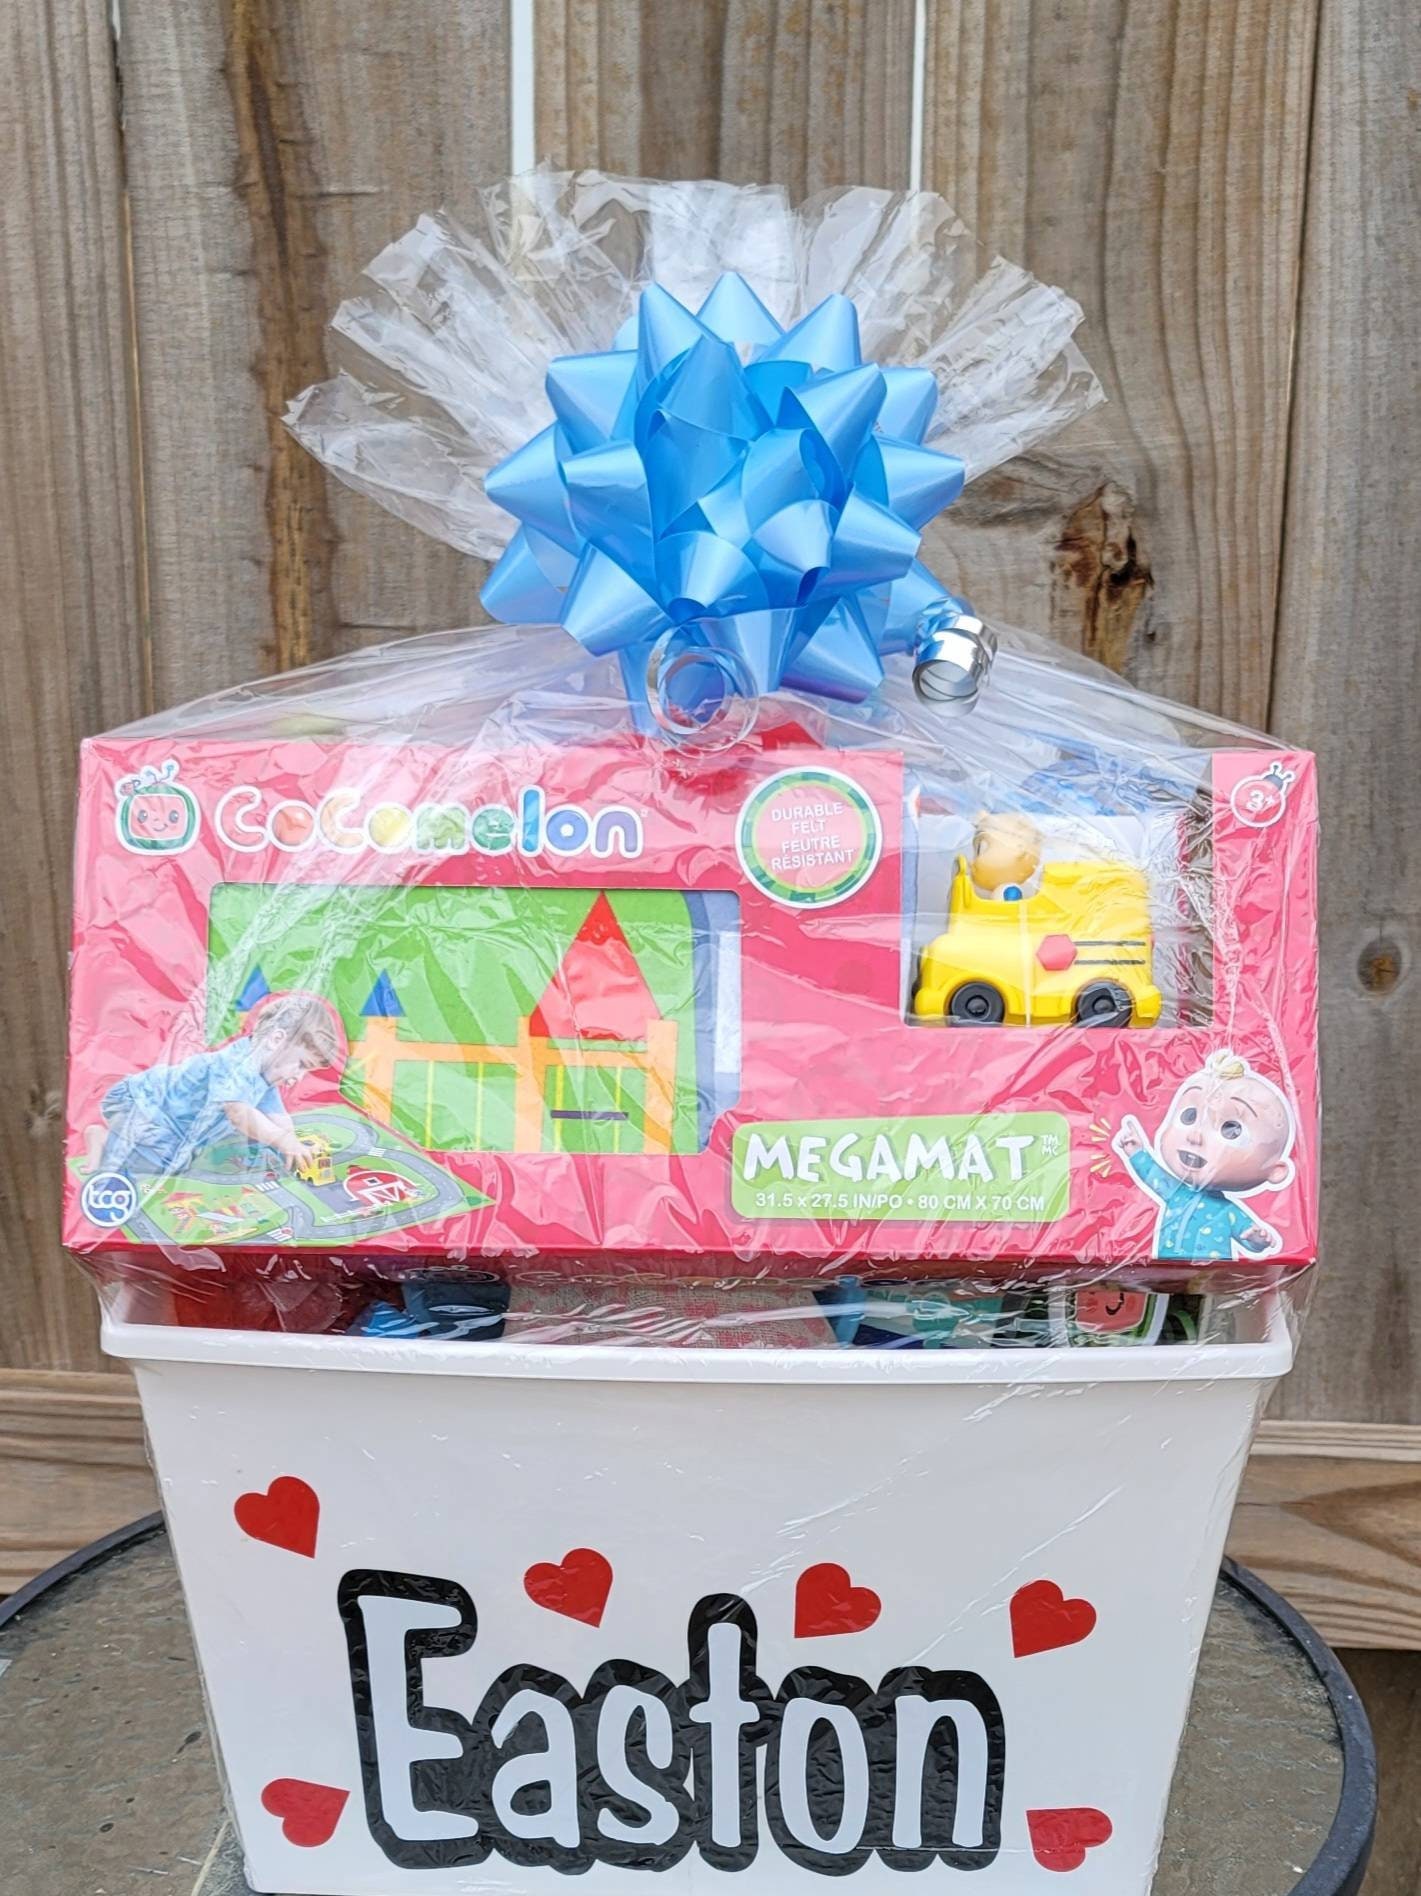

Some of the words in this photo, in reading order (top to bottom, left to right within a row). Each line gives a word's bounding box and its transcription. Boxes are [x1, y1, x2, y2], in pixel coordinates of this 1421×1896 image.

[214, 784, 643, 858] CoComelon
[771, 801, 844, 821] DURABLE
[792, 819, 826, 834] FELT
[782, 835, 841, 853] FEUTRE
[743, 1133, 1035, 1183] MEGAMAT
[755, 1191, 793, 1208] 31.5
[811, 1192, 849, 1209] 27.5
[917, 1194, 939, 1210] 80
[943, 1194, 972, 1211] CM
[975, 1195, 988, 1211] X
[991, 1195, 1013, 1211] 70
[1016, 1195, 1045, 1211] CM
[338, 1568, 1006, 1876] Easton
